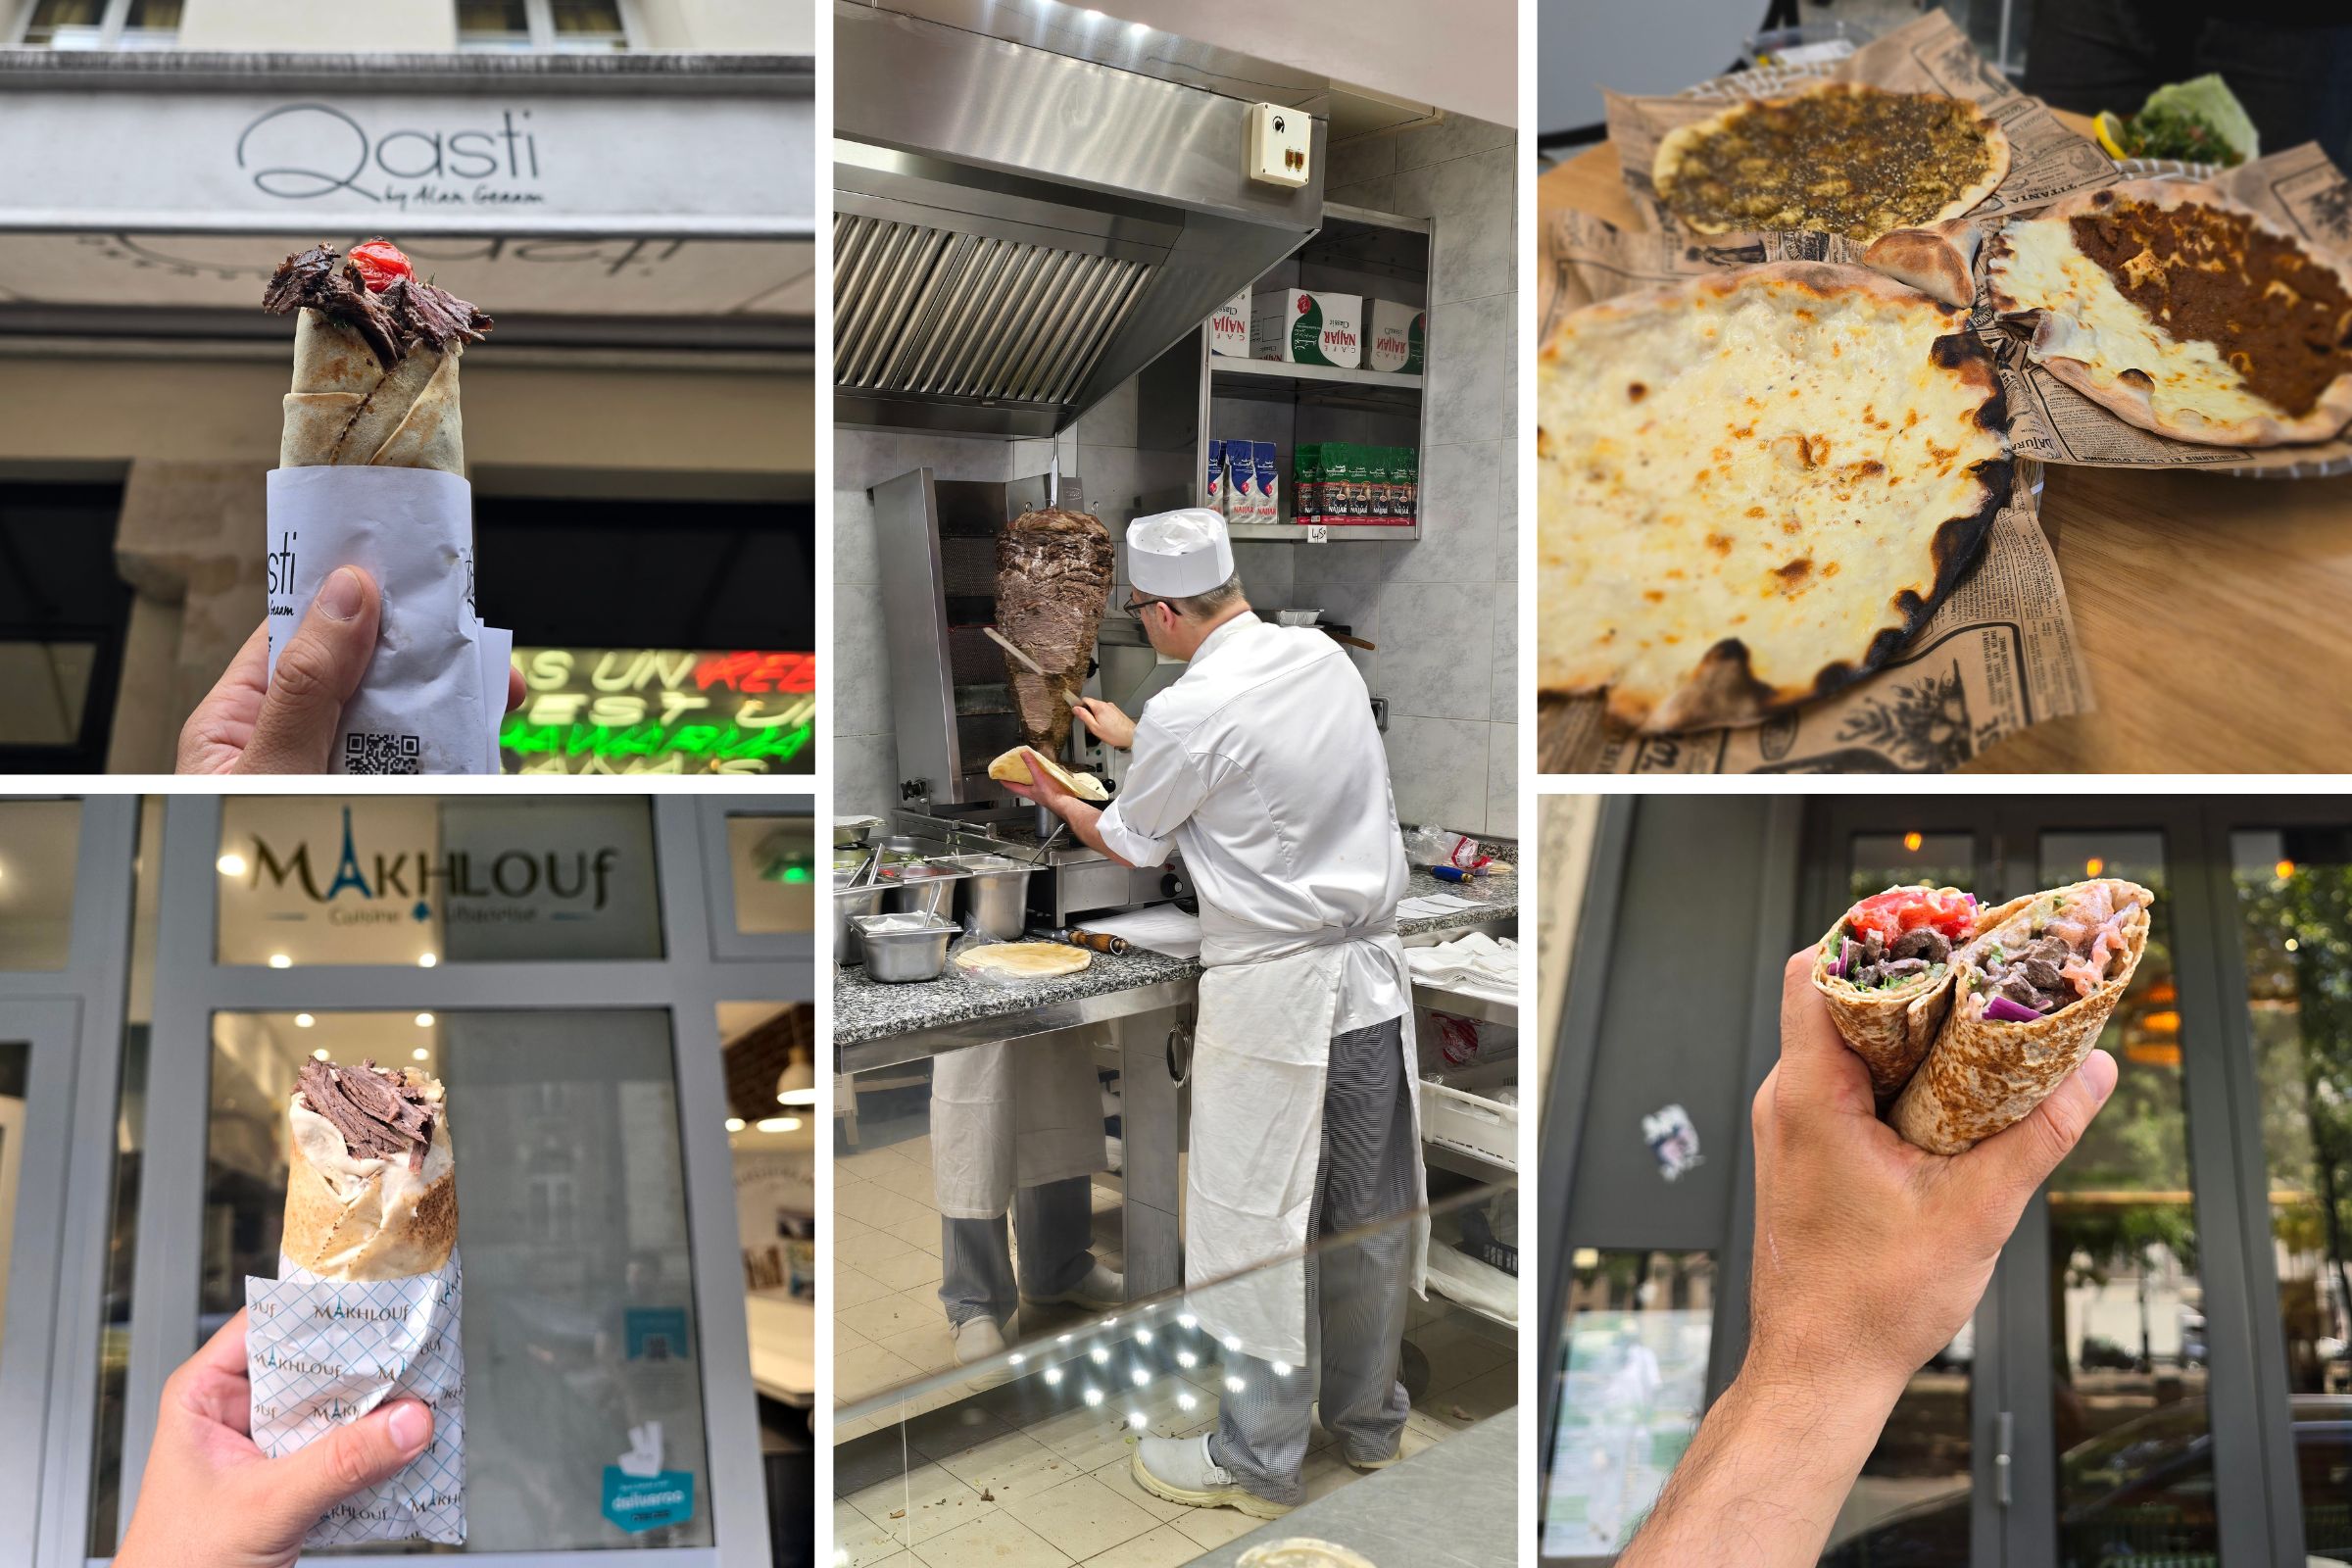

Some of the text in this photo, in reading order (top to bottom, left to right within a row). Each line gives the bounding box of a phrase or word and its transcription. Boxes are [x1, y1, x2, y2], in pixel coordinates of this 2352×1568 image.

[237, 102, 539, 203] Qasti
[385, 183, 408, 212] by
[1330, 319, 1349, 328] Classic
[1324, 329, 1356, 347] NAJJAR
[2011, 436, 2054, 450] DATURA
[1328, 505, 1348, 514] NAJJAR
[514, 650, 574, 690] S
[591, 649, 698, 691] UN
